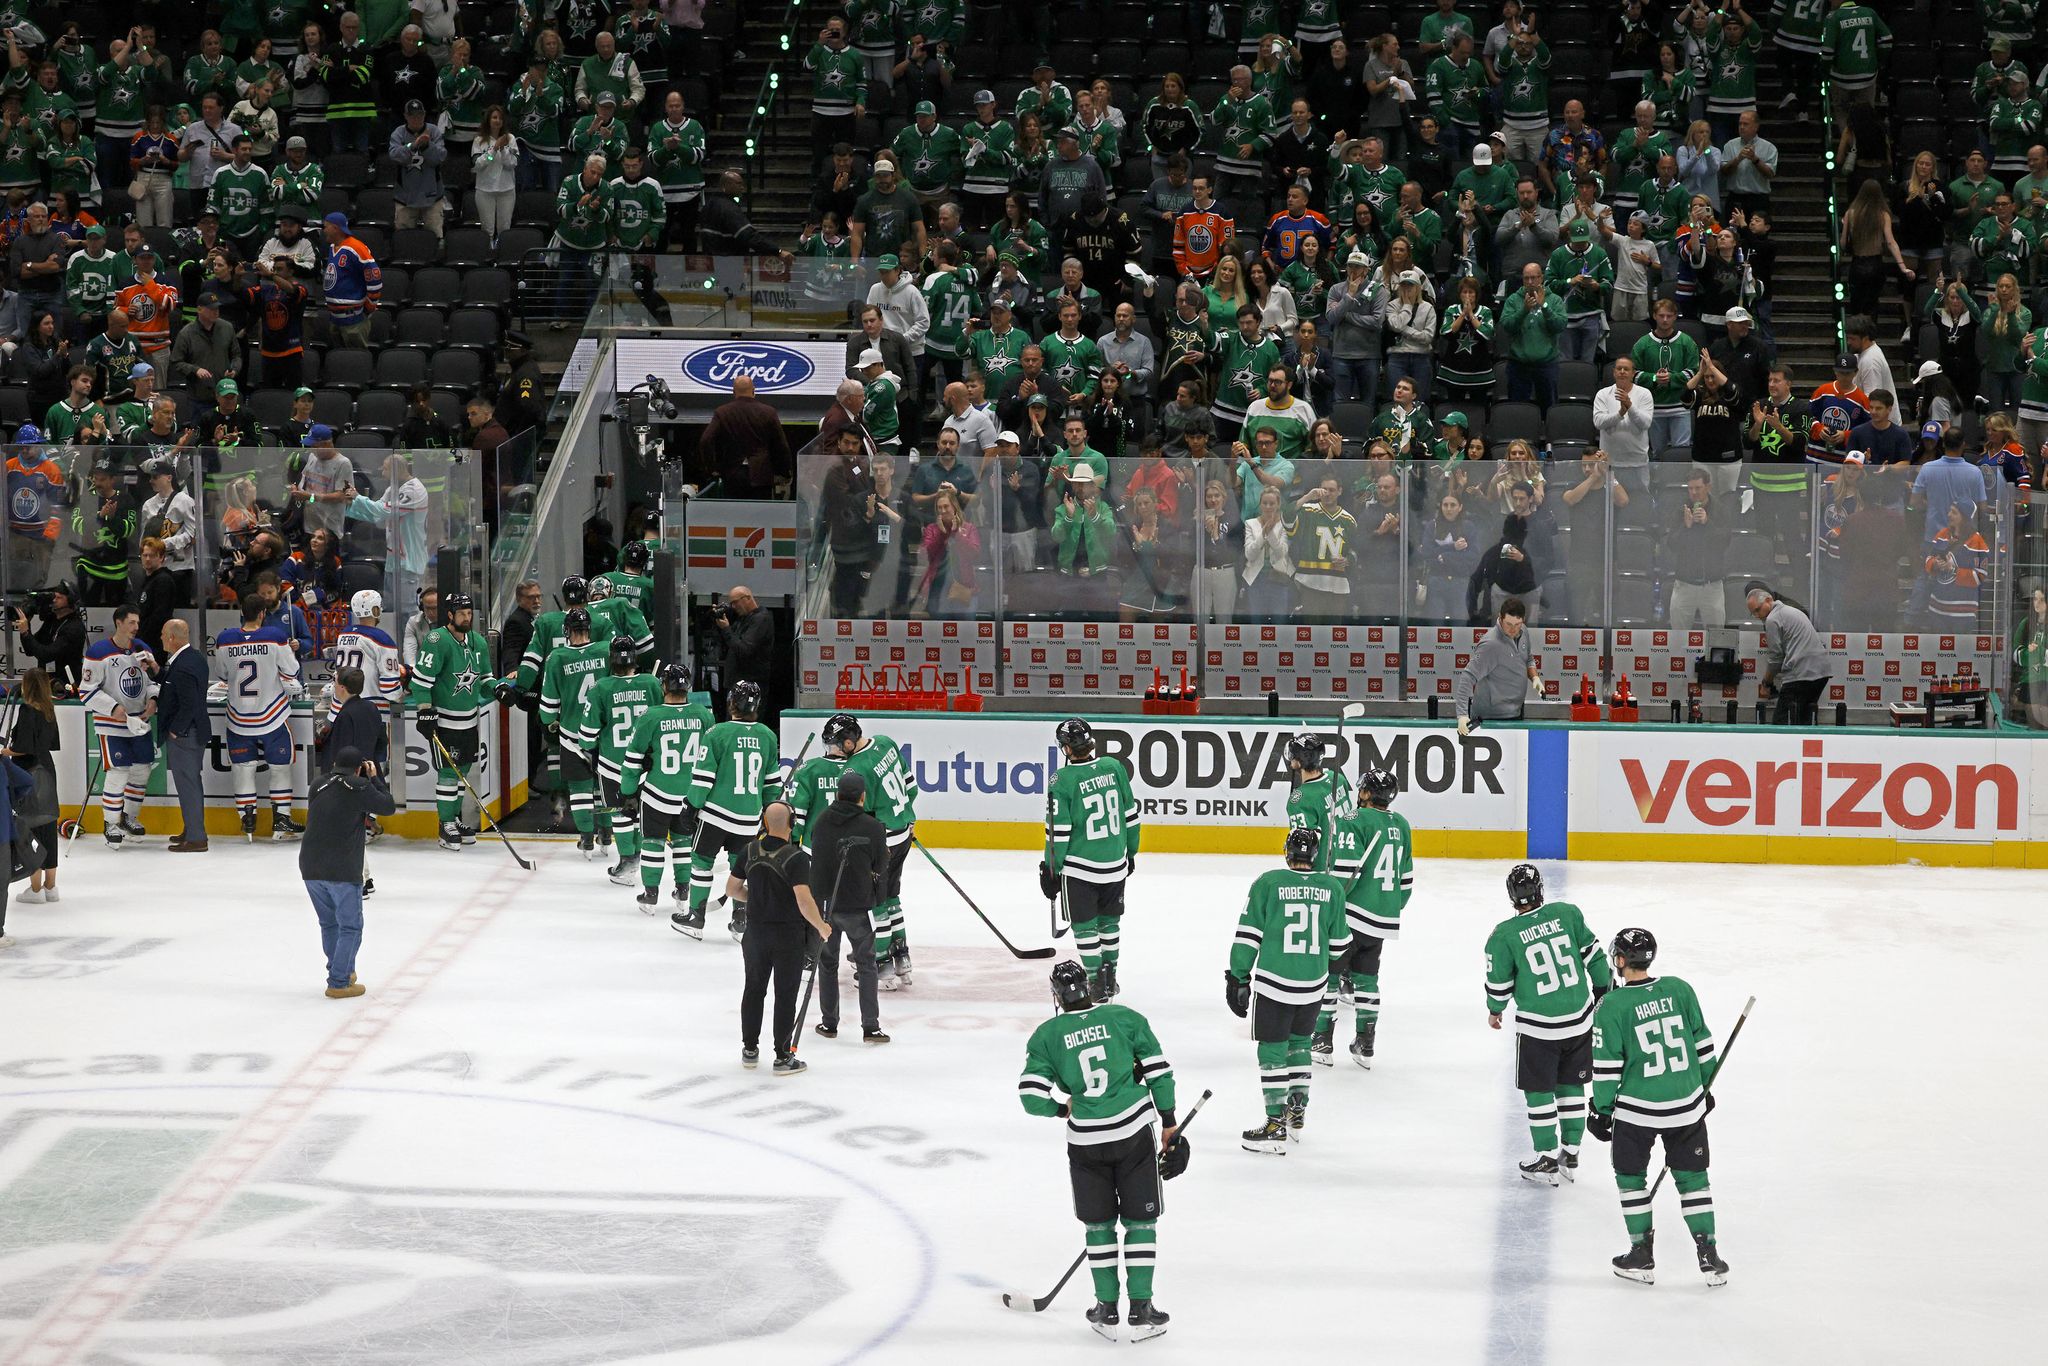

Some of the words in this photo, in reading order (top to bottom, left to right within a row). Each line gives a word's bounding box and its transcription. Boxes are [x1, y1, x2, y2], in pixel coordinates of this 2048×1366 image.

[1852, 28, 1868, 59] 4
[943, 294, 970, 326] 14
[708, 350, 788, 384] Ford
[616, 584, 642, 596] SEGUIN
[228, 644, 268, 658] BOUCHARD
[339, 635, 360, 646] PERRY
[386, 658, 398, 672] 90
[418, 650, 434, 668] 14
[562, 658, 606, 676] HEISKANEN
[238, 660, 260, 698] 2
[578, 673, 596, 704] 4
[612, 690, 647, 704] BOURQUE
[660, 718, 701, 732] GRANLUND
[660, 732, 700, 775] 64
[737, 736, 761, 750] STEEL
[733, 752, 762, 794] 18
[1079, 773, 1116, 794] PETROVIC
[1619, 739, 2019, 831] verizon
[1082, 789, 1120, 841] 28
[1134, 798, 1188, 816] ORTS
[1196, 799, 1269, 818] DRINK
[1338, 832, 1355, 850] 44
[1278, 886, 1332, 902] ROBERTSON
[1284, 904, 1320, 955] 21
[1519, 918, 1564, 945] DUCHENE
[1525, 934, 1580, 996] 95
[1634, 997, 1674, 1020] HARLEY
[1064, 1024, 1111, 1050] BICHSEL
[1634, 1015, 1689, 1078] 55
[1078, 1044, 1109, 1098] 6
